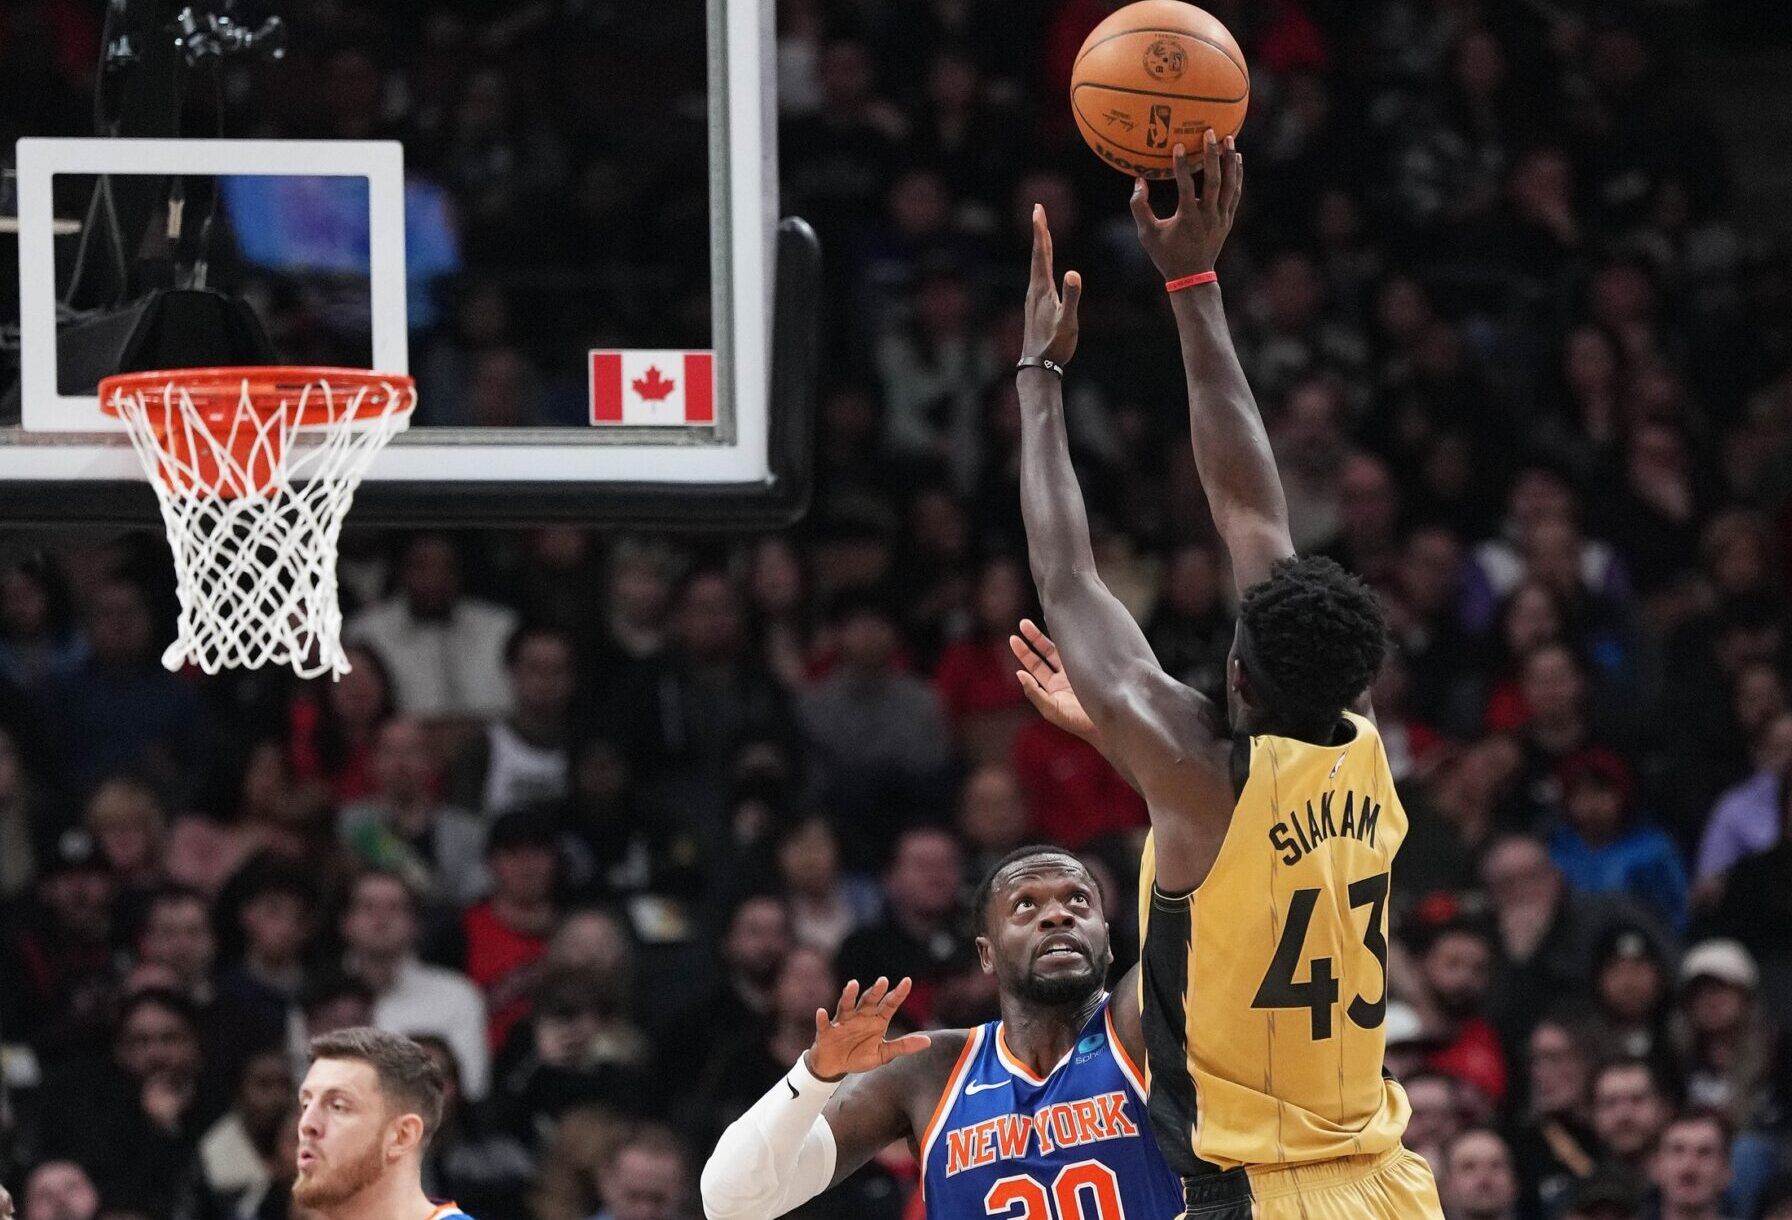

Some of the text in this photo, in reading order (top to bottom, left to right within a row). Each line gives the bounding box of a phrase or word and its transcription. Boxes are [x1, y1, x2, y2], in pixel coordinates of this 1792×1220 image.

[1269, 789, 1381, 866] SIAKAM
[1250, 871, 1390, 1041] 43
[945, 1090, 1140, 1179] NEW YORK
